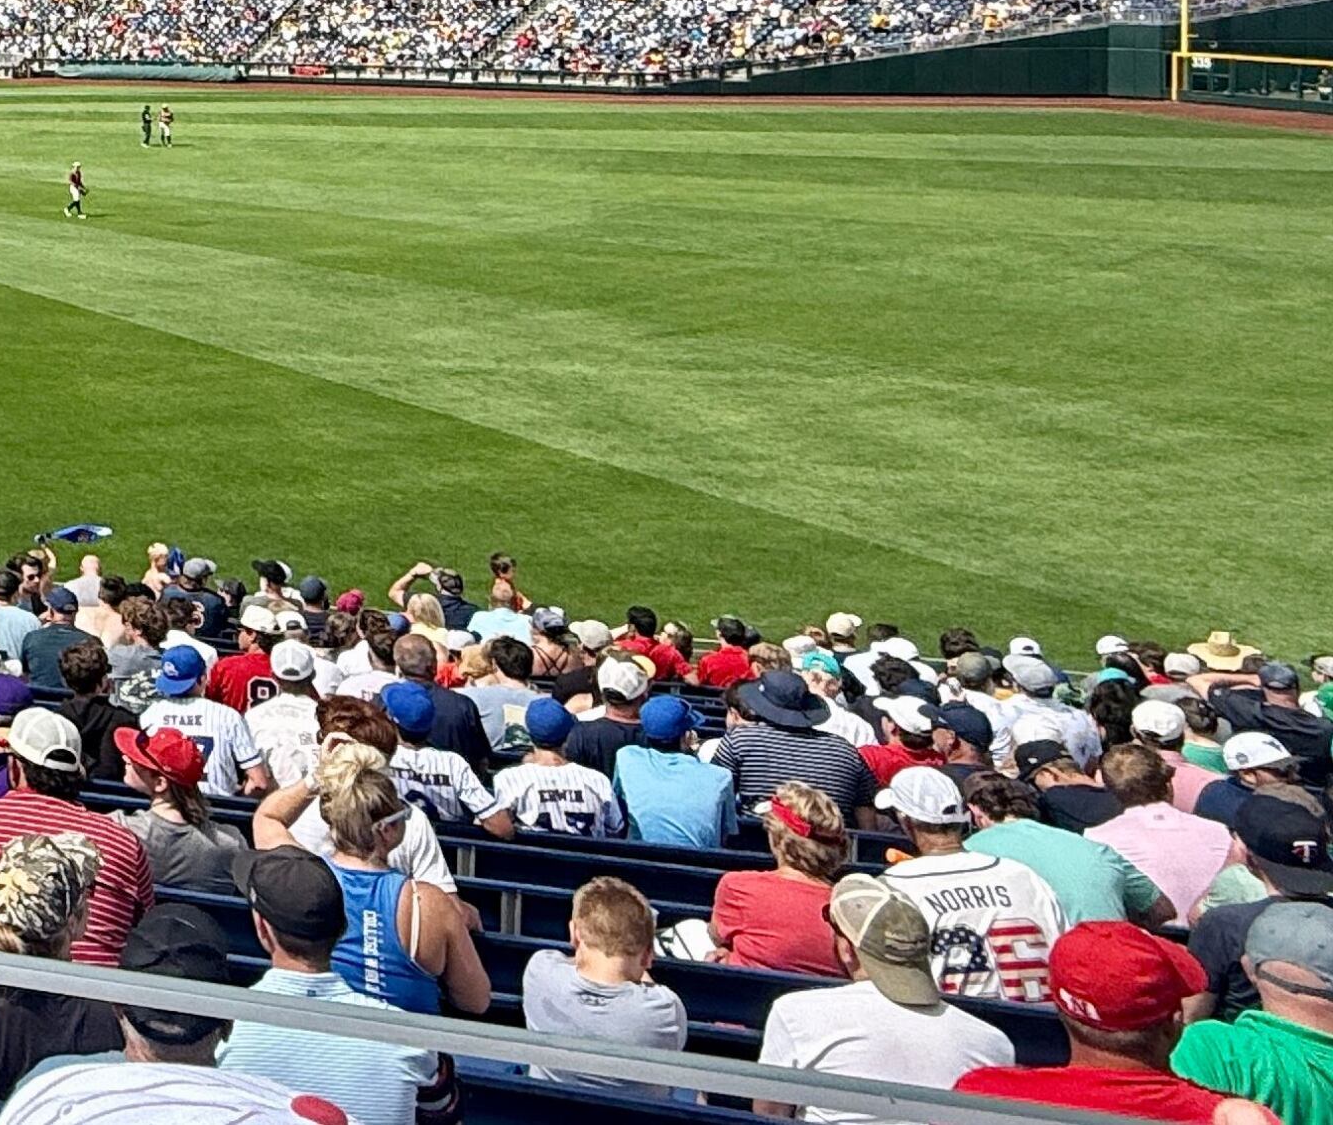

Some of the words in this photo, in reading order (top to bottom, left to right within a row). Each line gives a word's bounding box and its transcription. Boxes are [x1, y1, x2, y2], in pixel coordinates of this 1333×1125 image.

[163, 715, 203, 726] STARK
[538, 789, 584, 803] ERWIN
[924, 885, 1012, 916] NORRIS
